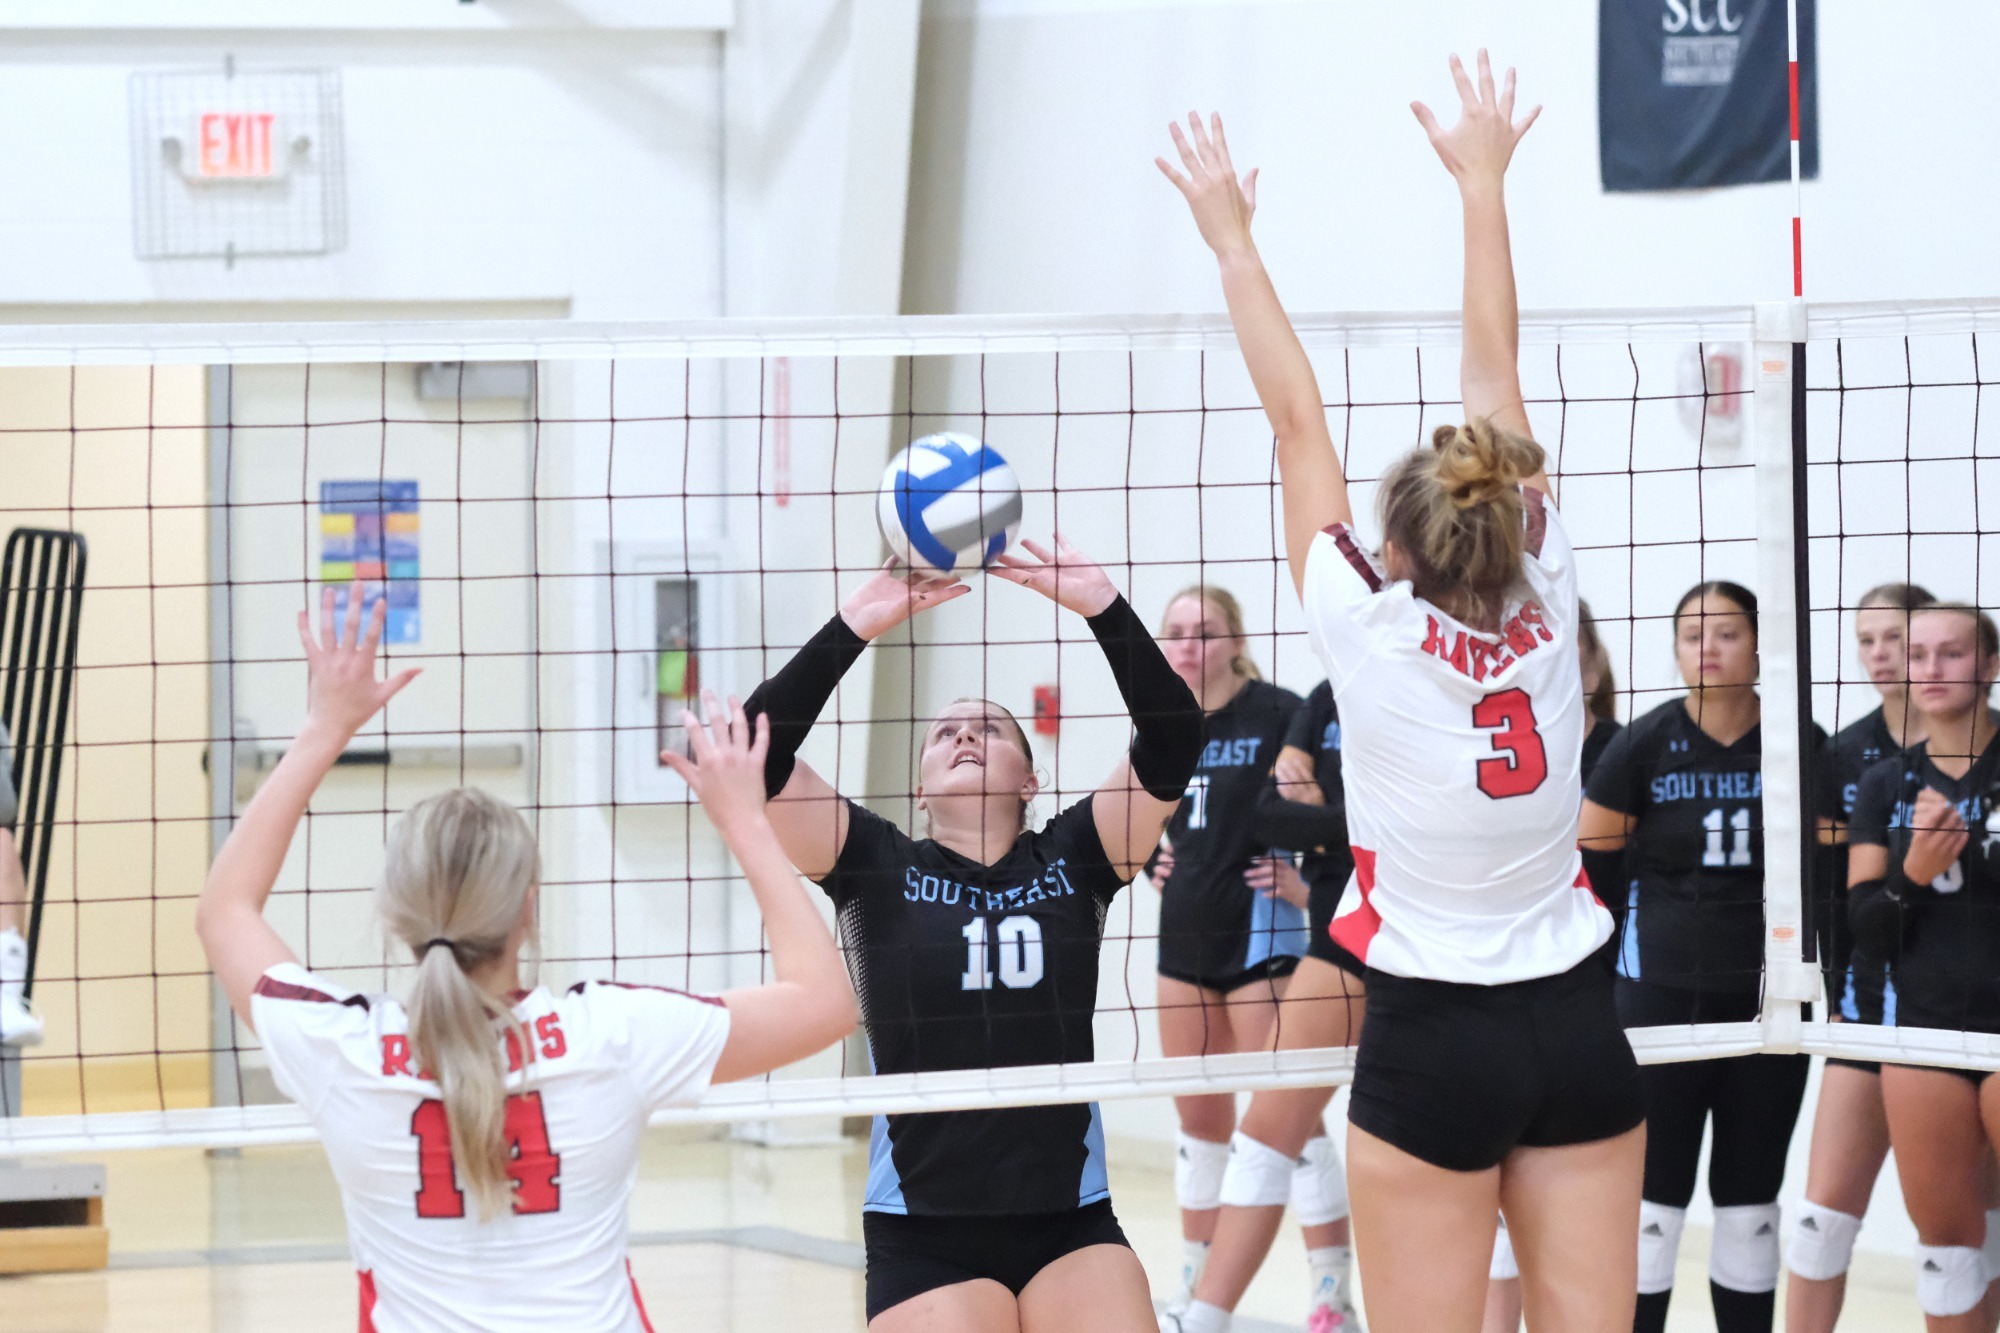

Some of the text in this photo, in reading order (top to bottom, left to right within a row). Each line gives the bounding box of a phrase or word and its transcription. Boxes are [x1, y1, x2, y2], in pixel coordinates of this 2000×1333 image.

[200, 113, 275, 177] EXIT
[1472, 687, 1547, 800] 3
[1702, 808, 1751, 867] 11
[903, 858, 1075, 911] SOUTHEAST
[961, 915, 1044, 991] 10
[410, 1090, 561, 1218] 14
